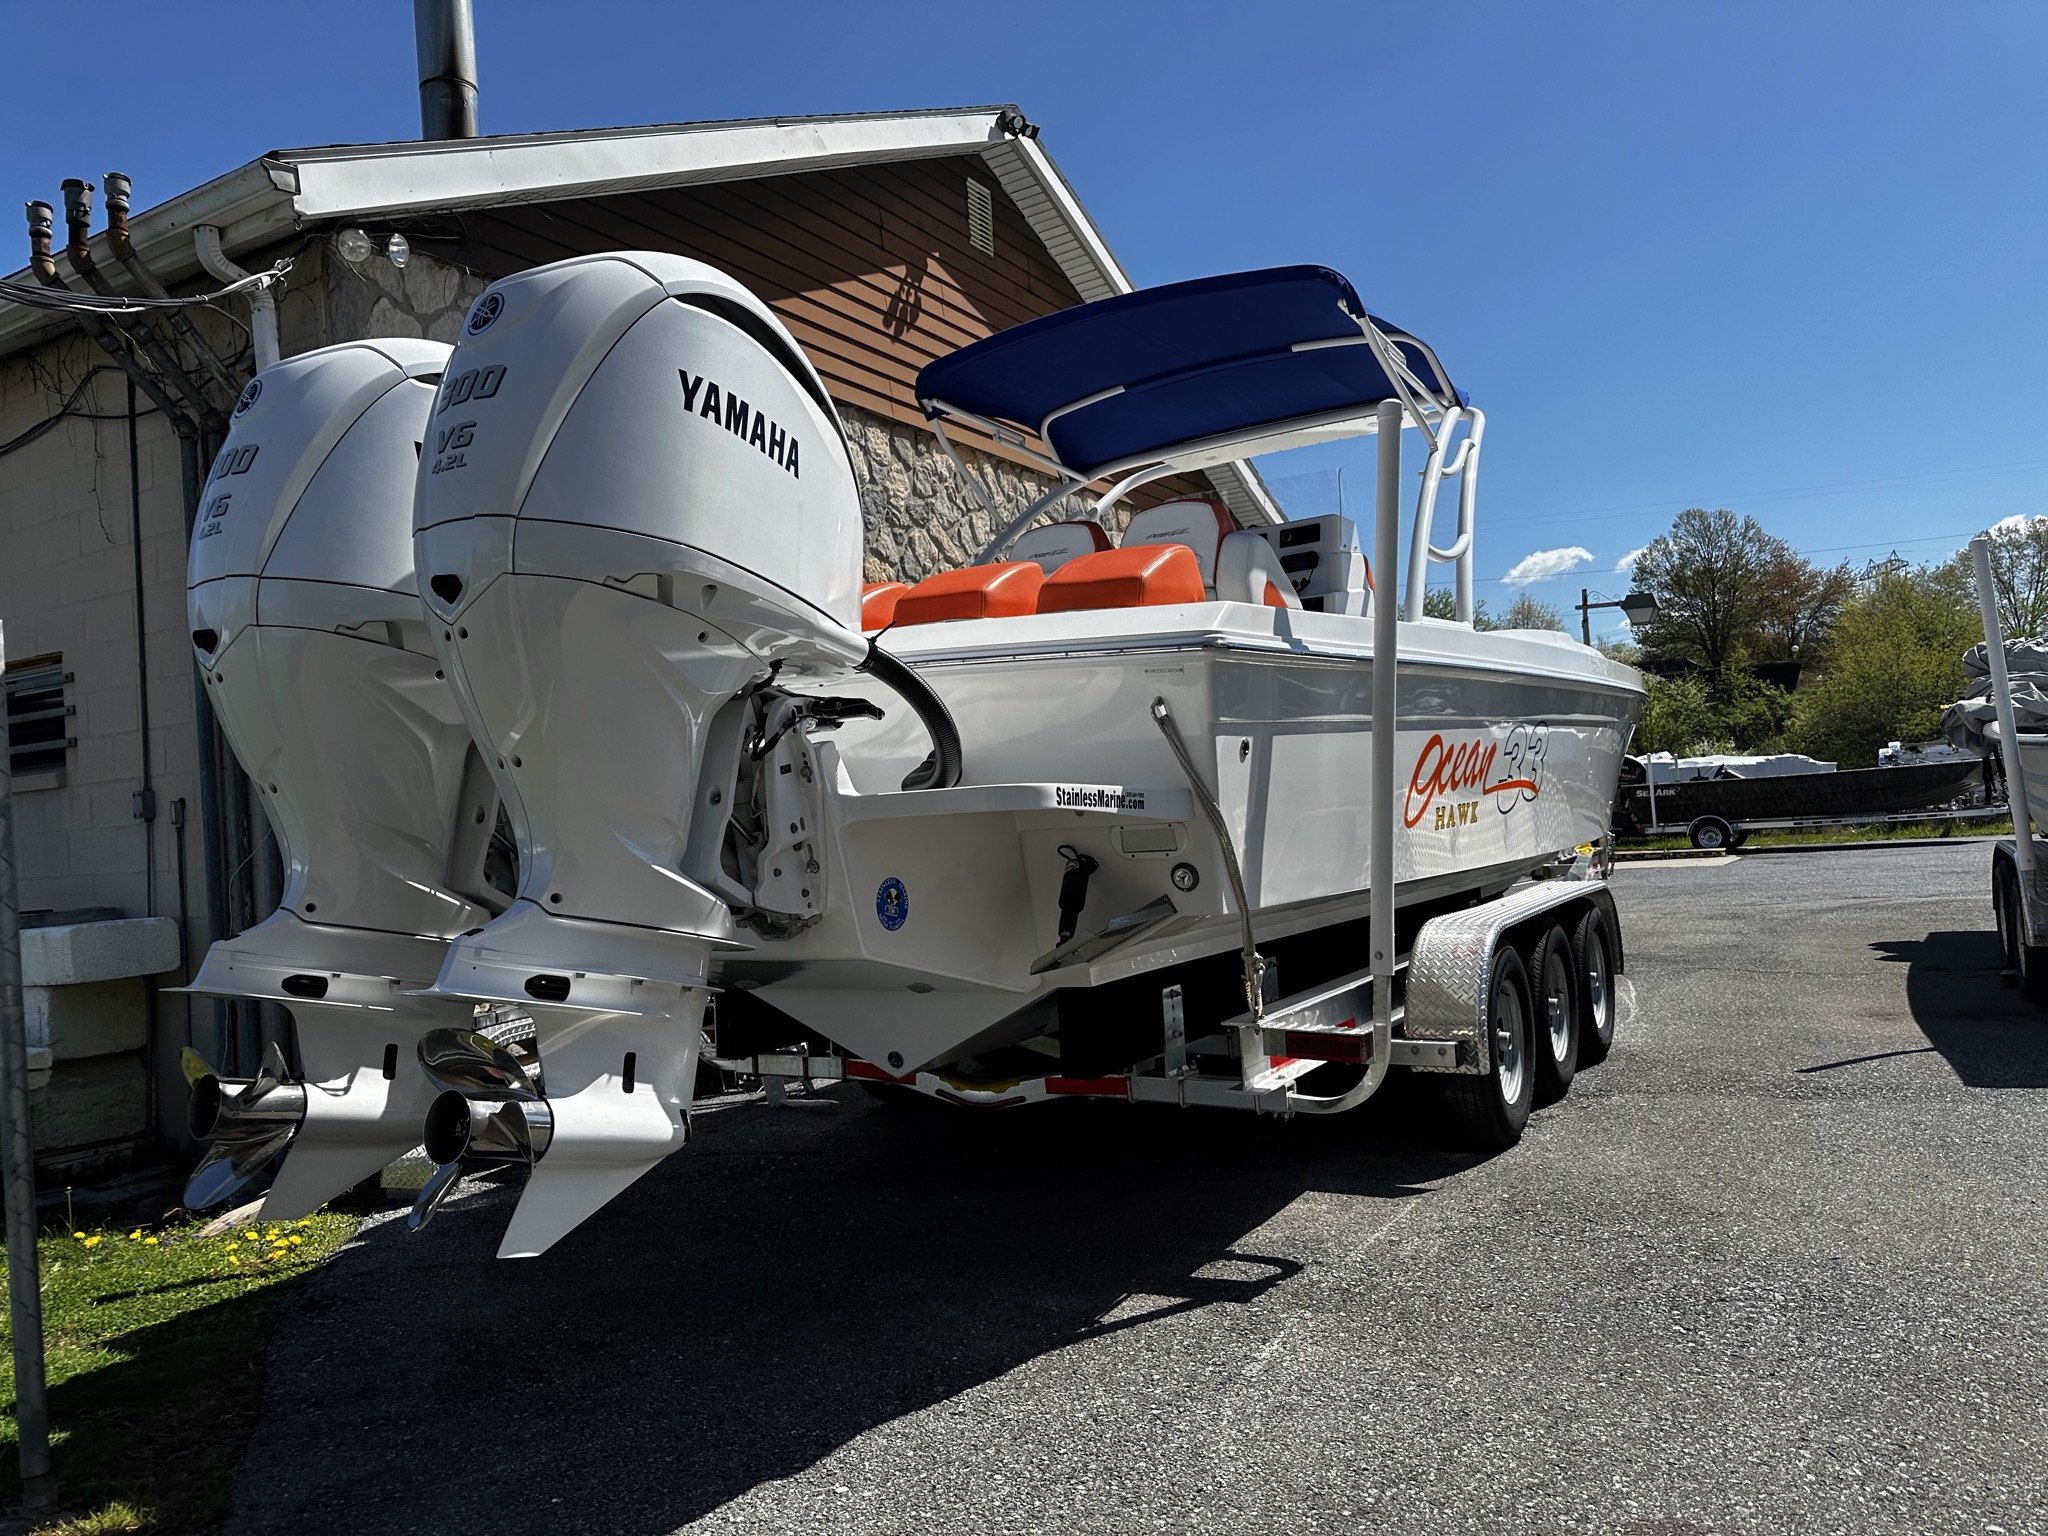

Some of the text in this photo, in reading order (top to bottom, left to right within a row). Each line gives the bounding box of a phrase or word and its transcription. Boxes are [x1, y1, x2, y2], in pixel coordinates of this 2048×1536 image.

[437, 364, 507, 417] 300
[438, 420, 477, 454] V6
[678, 368, 799, 480] YAMAHA
[432, 452, 467, 475] 4.2L
[1404, 720, 1549, 828] Ocean 33
[1056, 786, 1144, 810] StainlessMarine.com
[1636, 787, 1680, 798] SEARK
[1435, 801, 1478, 830] HAWK
